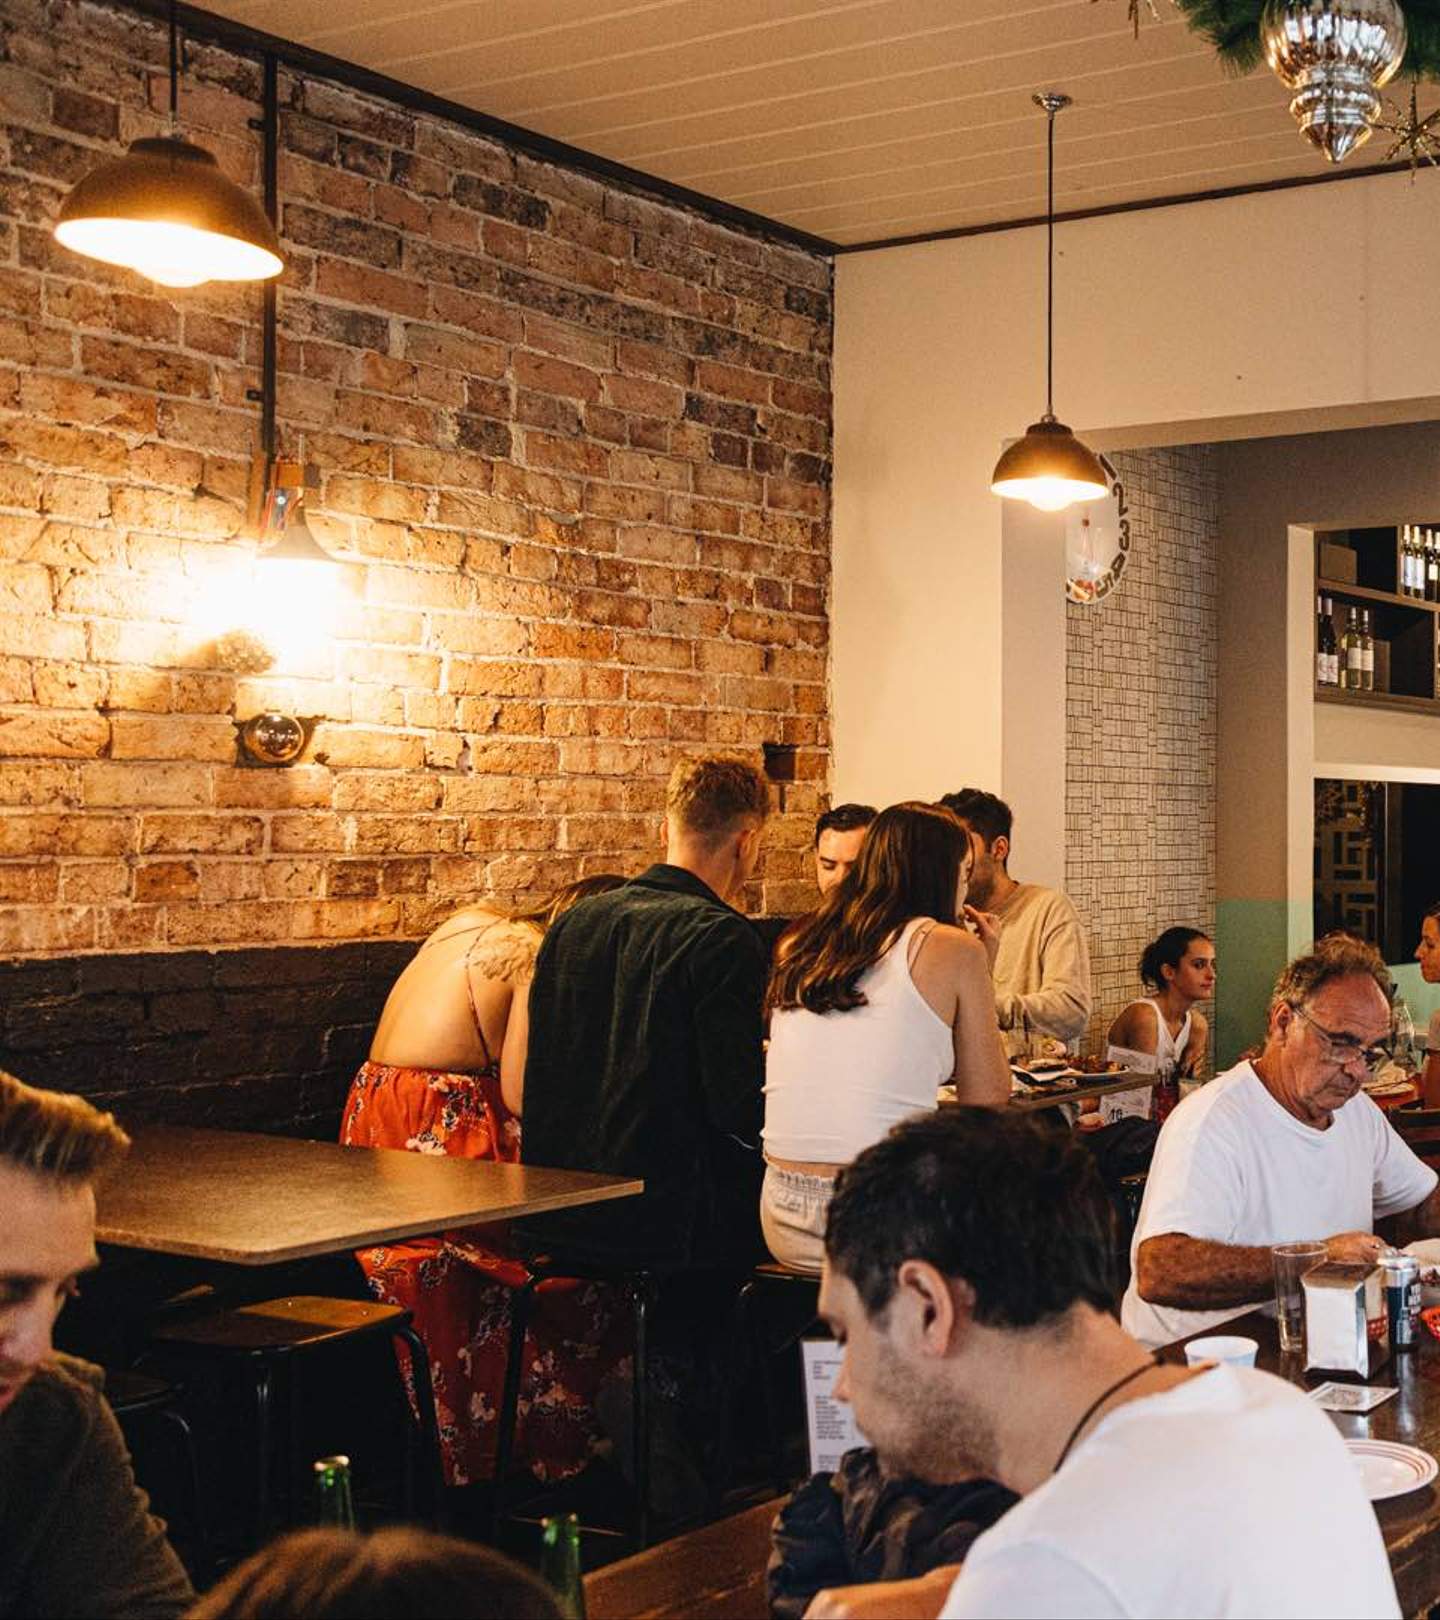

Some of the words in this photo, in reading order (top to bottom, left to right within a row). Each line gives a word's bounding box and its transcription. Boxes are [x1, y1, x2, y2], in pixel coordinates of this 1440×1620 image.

[1099, 454, 1117, 480] 1
[1112, 481, 1128, 517] 2
[1119, 519, 1130, 551] 3
[1110, 551, 1126, 581] 4
[1096, 572, 1114, 598] 5
